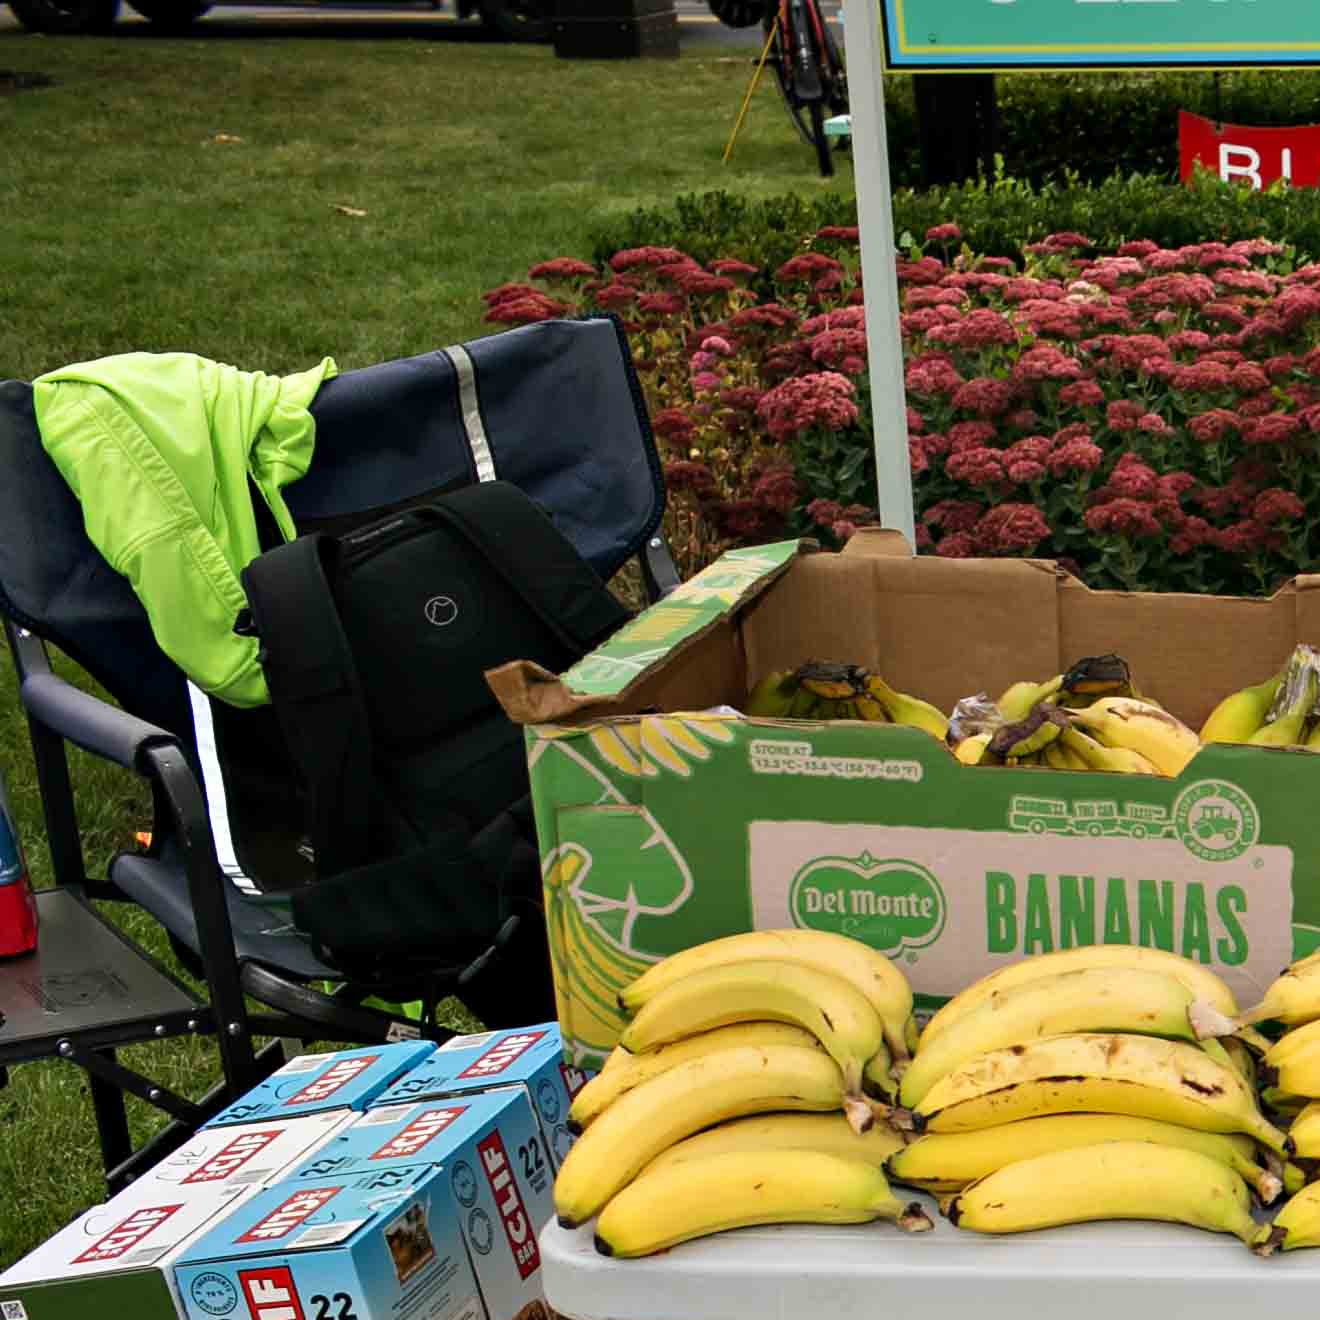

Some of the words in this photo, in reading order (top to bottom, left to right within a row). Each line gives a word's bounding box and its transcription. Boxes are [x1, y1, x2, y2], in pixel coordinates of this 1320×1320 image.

[803, 887, 847, 914] Del
[849, 888, 934, 919] Monte
[984, 871, 1250, 967] BANANAS
[483, 1033, 545, 1070] CLIF
[309, 1056, 375, 1095] CLIF
[392, 1107, 463, 1149] CLIF
[203, 1131, 277, 1174] CLIF
[518, 1137, 544, 1179] 22
[482, 1147, 528, 1245] CLIF
[95, 1208, 170, 1253] CLIF
[254, 1197, 324, 1241] CLIF
